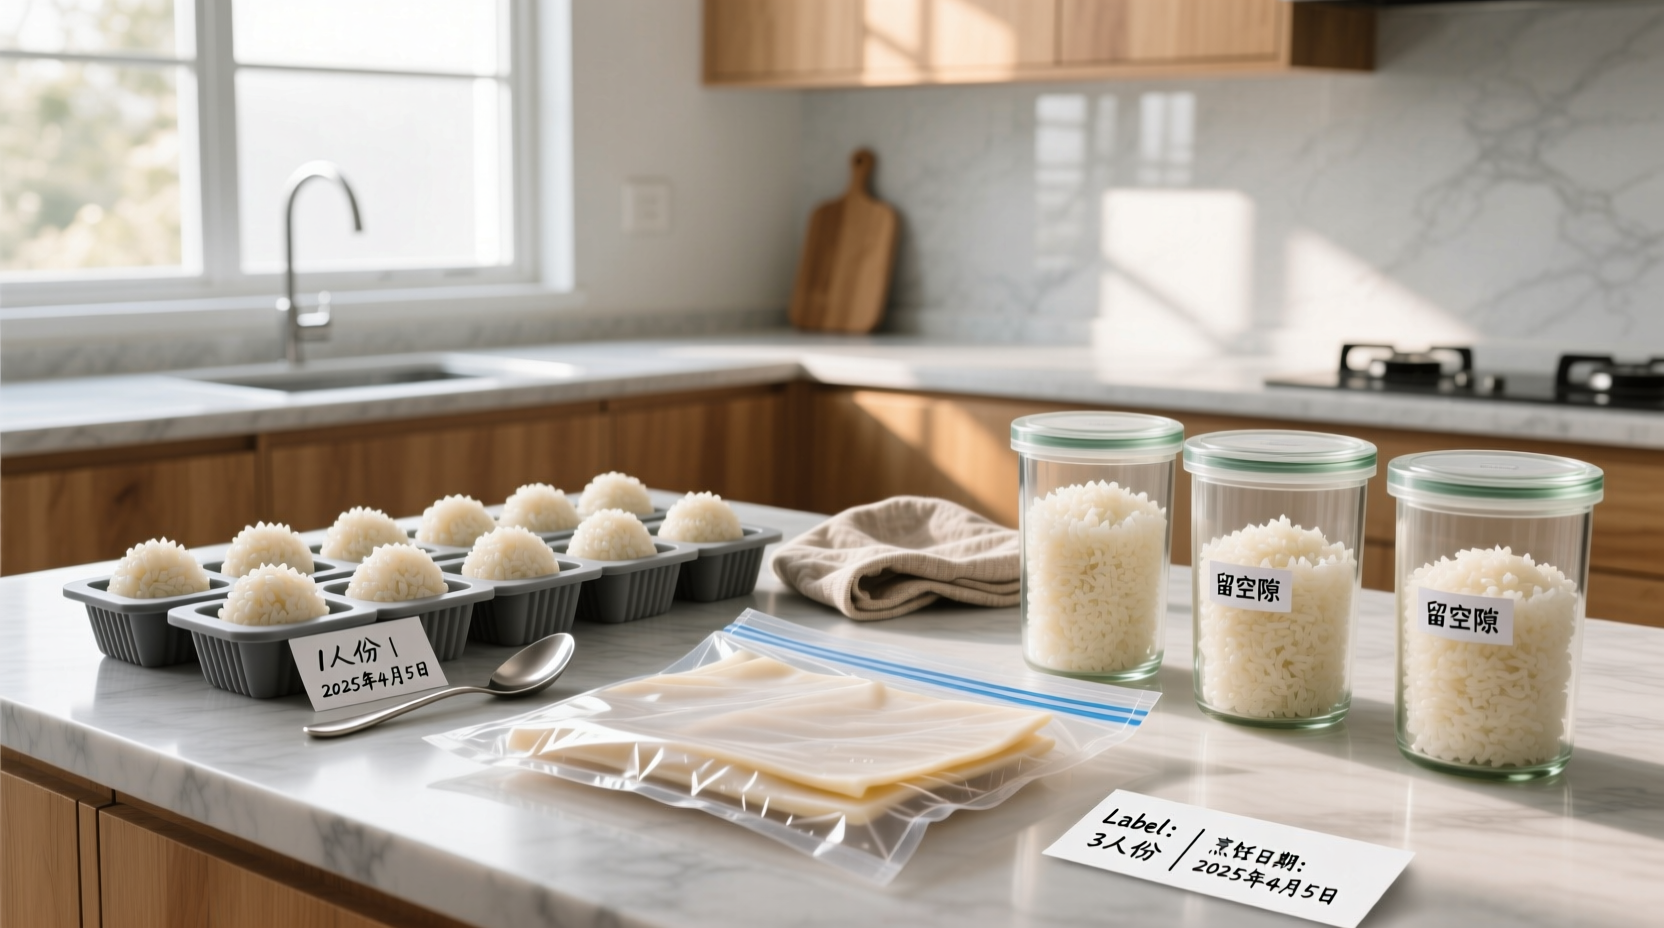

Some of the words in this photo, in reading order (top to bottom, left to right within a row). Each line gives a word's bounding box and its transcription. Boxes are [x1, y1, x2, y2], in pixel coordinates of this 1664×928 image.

[1217, 572, 1281, 603] 留空隙
[1427, 600, 1499, 635] 留空隙
[321, 661, 429, 698] 2025年4月5日
[1102, 808, 1177, 838] Label:
[1086, 832, 1162, 862] 3人份
[1191, 859, 1338, 905] 2025年4月5日
